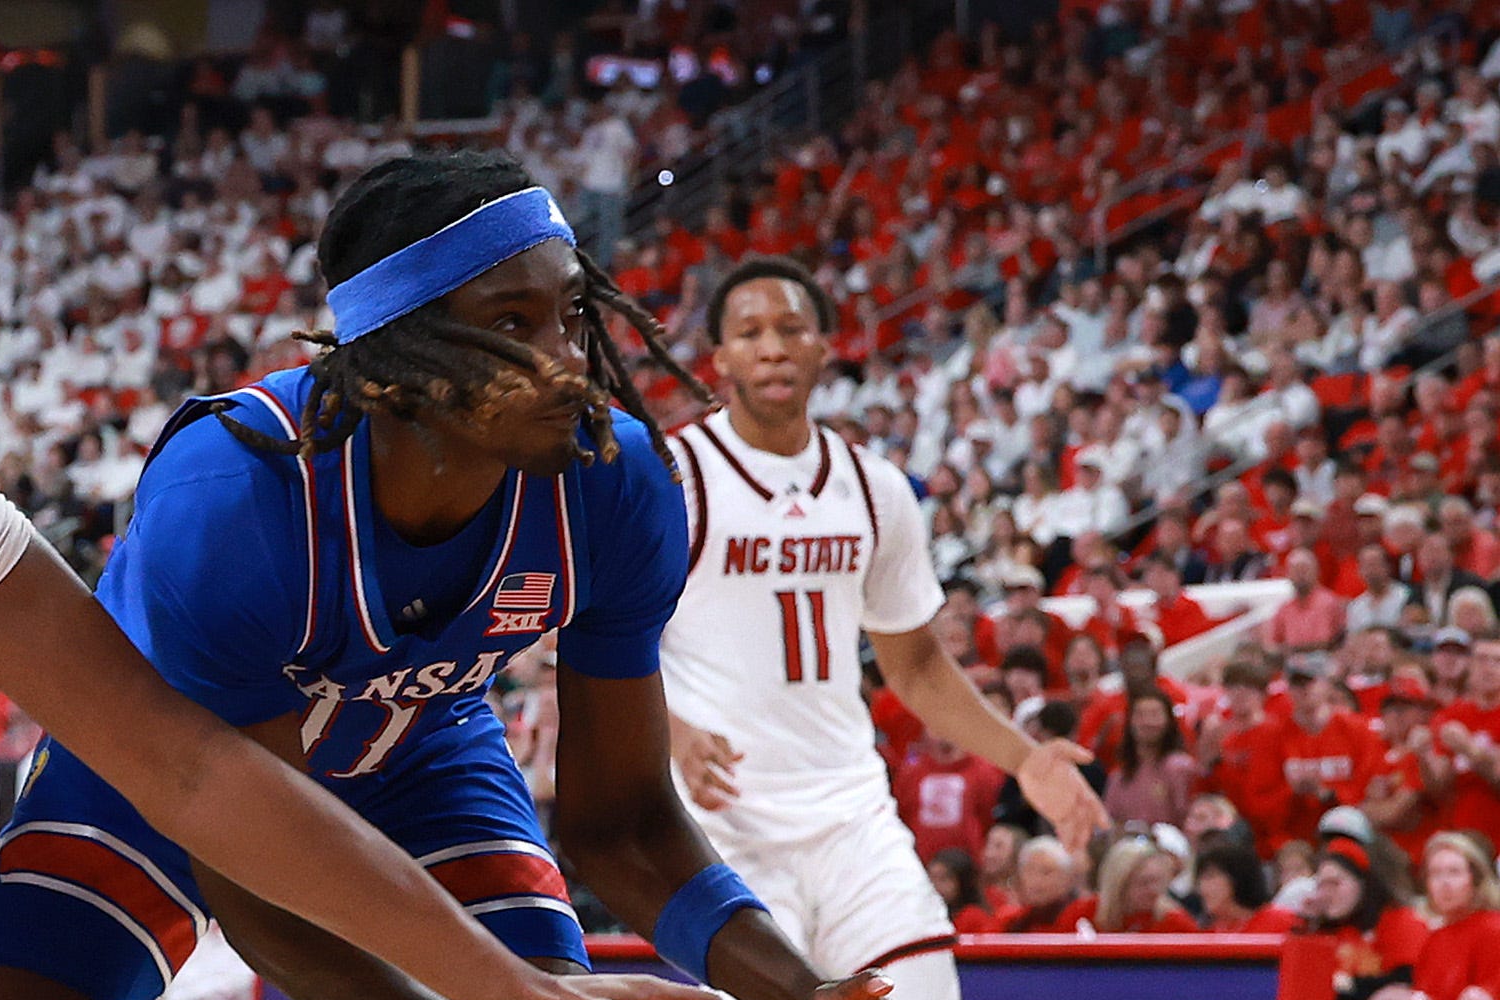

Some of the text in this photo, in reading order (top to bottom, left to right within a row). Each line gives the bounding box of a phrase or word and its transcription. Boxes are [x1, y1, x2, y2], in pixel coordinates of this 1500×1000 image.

[724, 535, 861, 575] NC STATE
[488, 611, 549, 634] XII
[774, 590, 830, 682] 11
